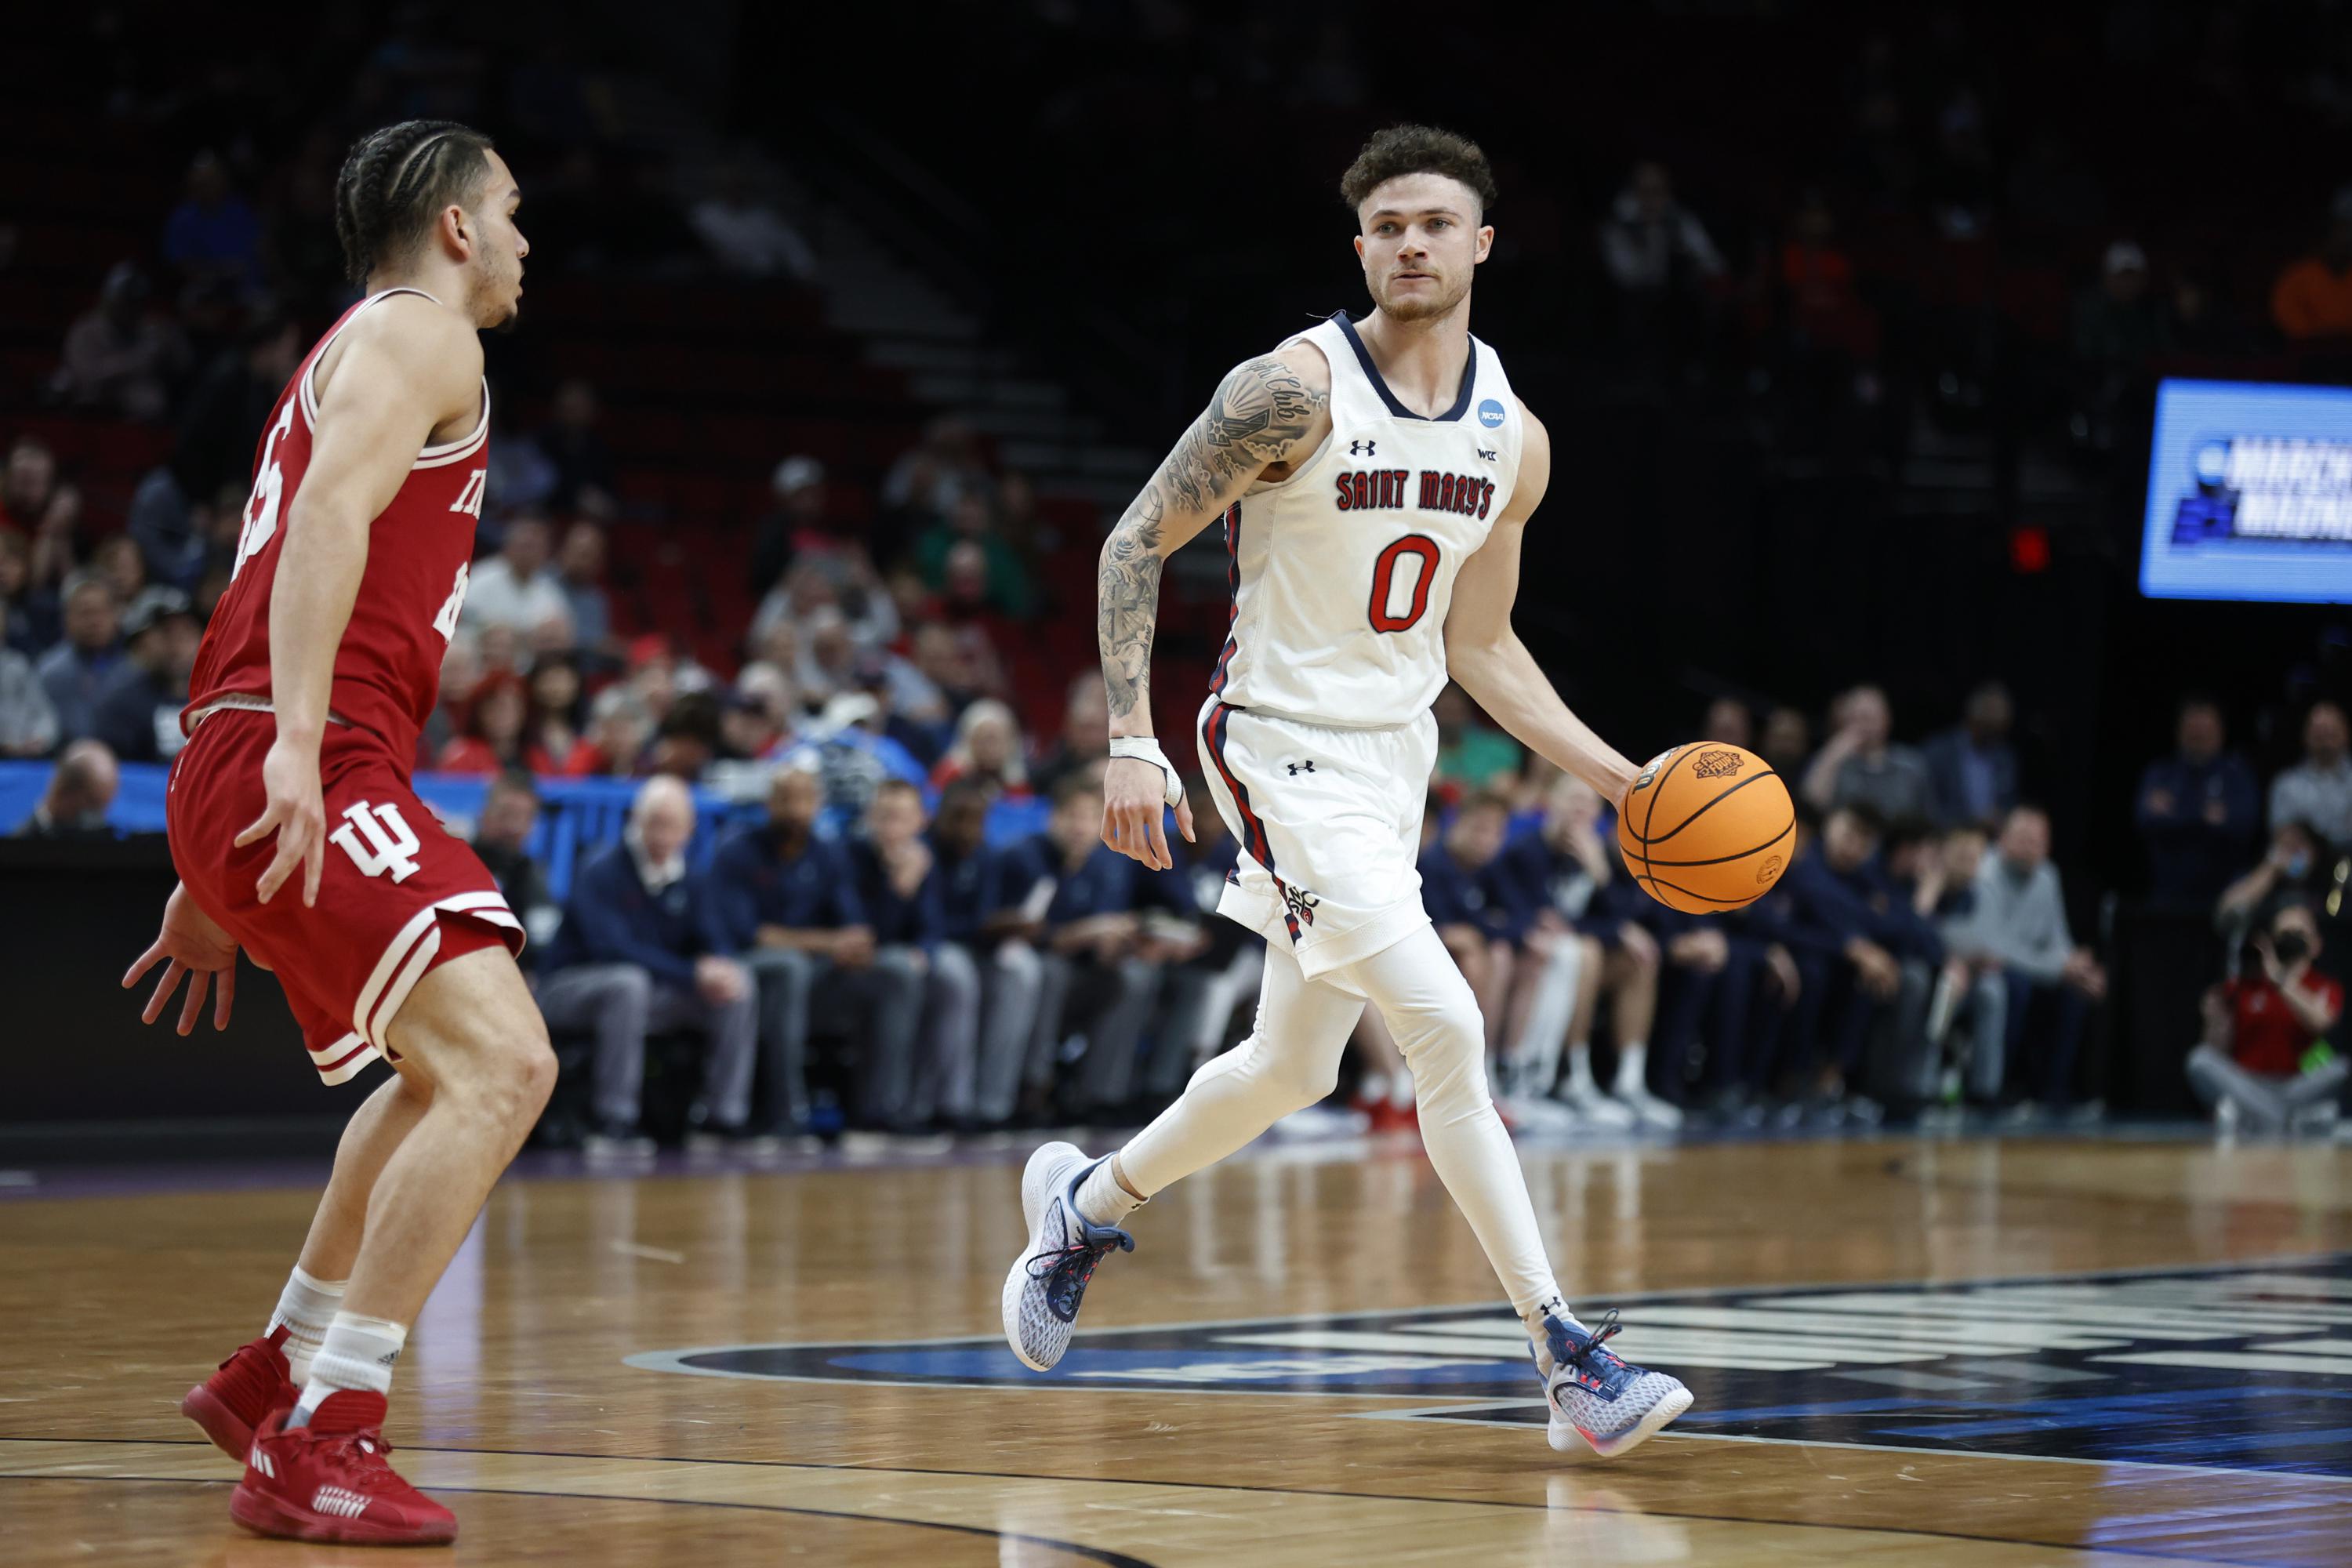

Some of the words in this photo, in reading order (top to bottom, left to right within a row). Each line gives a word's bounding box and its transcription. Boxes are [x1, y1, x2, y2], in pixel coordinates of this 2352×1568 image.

[1481, 412, 1504, 421] NCAA
[1477, 448, 1497, 462] WCC
[1336, 470, 1409, 510] SAINT
[1418, 470, 1495, 521] MARY'S
[1368, 533, 1440, 633] 0
[1700, 751, 1726, 767] FINAL
[1708, 755, 1733, 775] FOUR
[328, 800, 421, 884] IU
